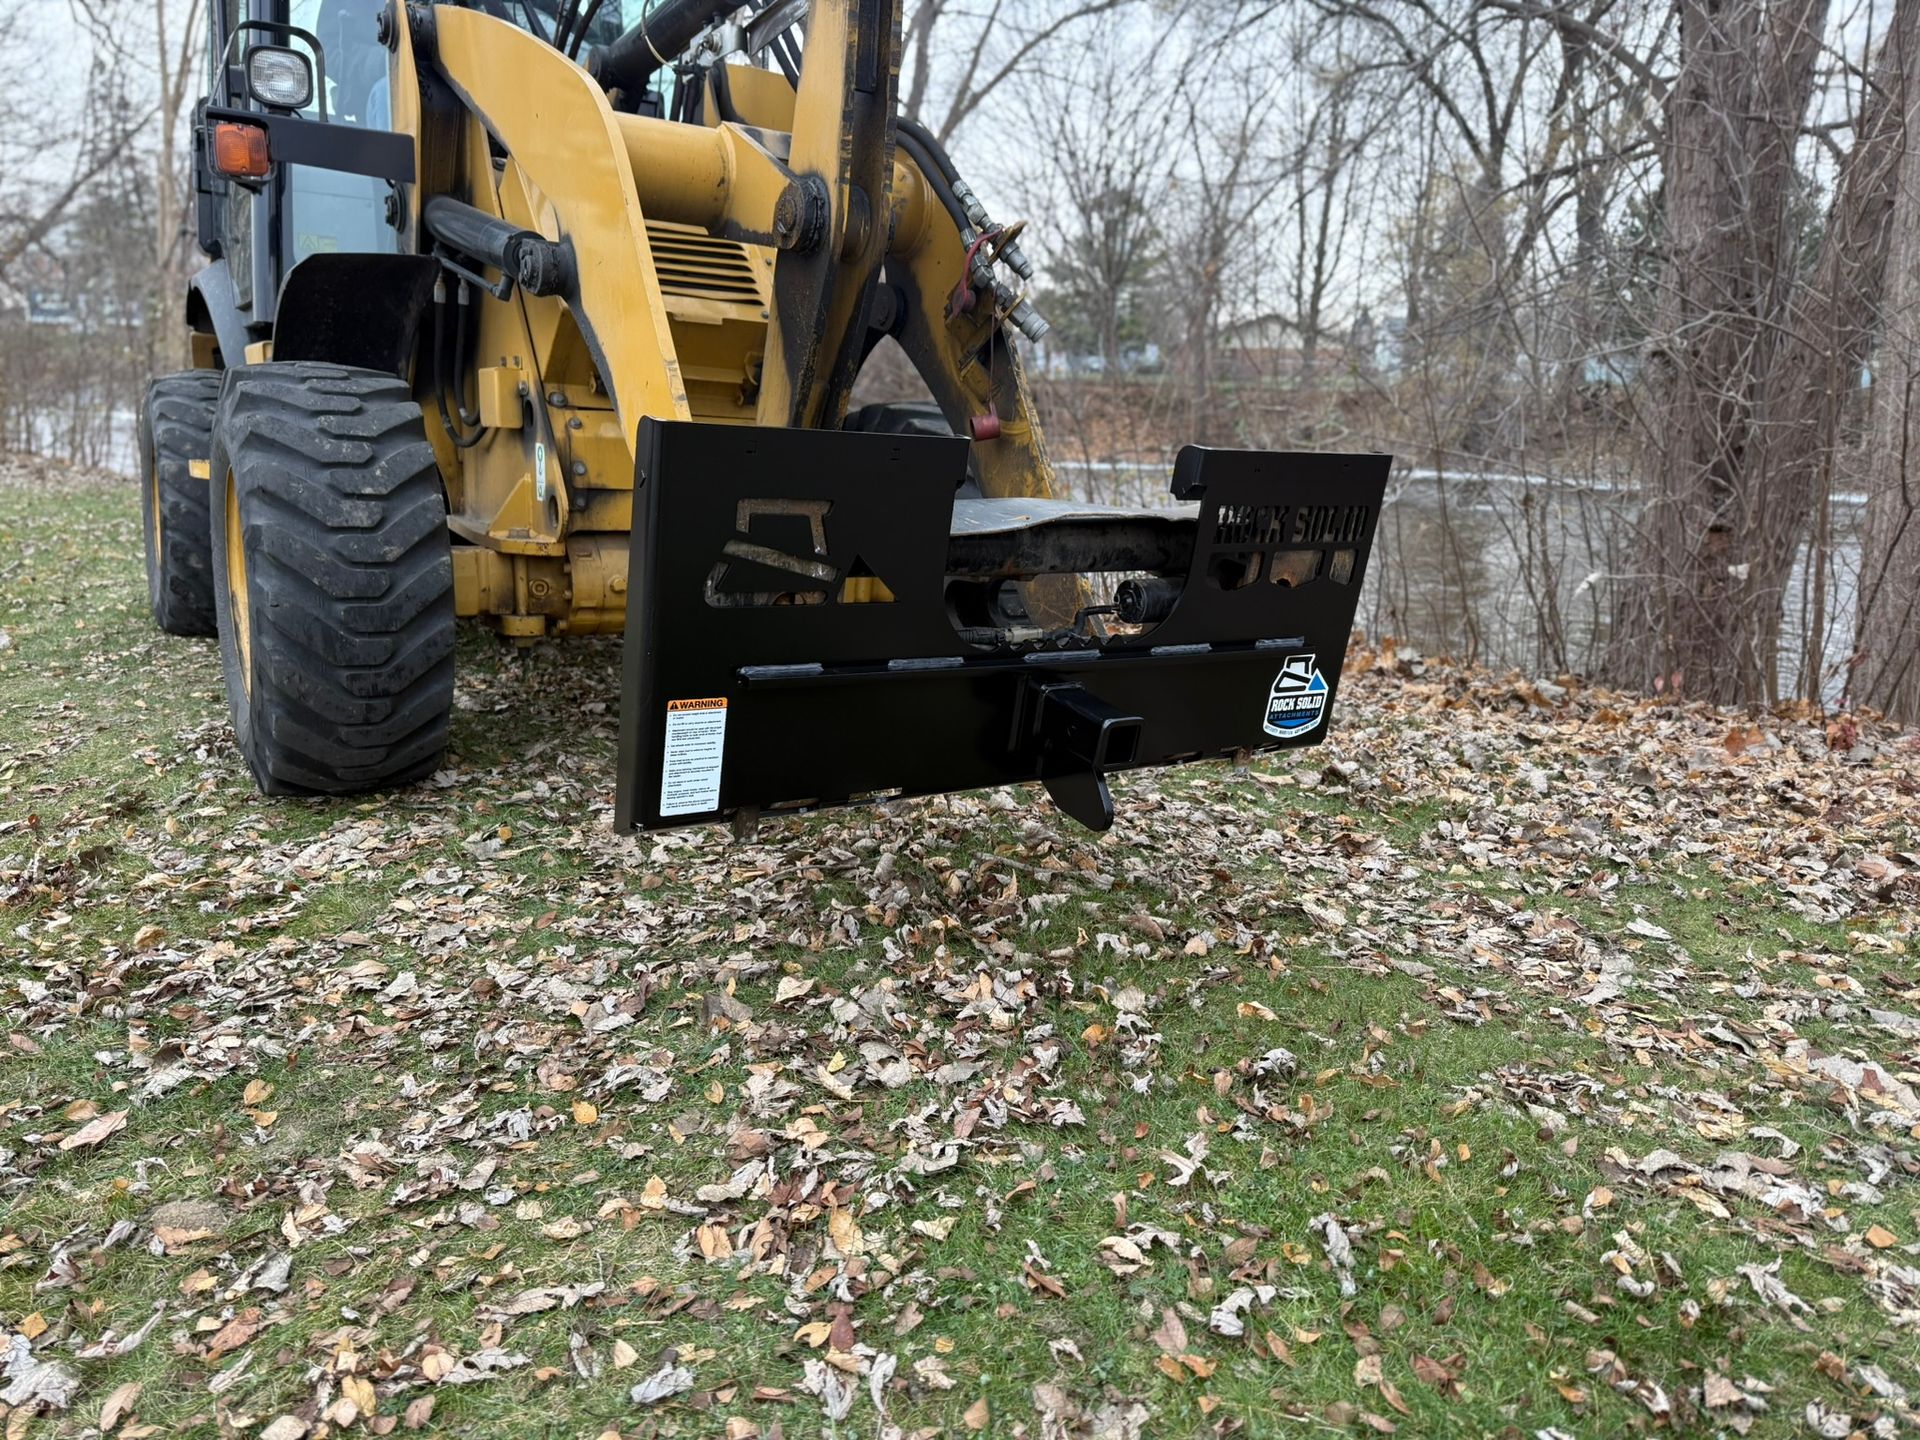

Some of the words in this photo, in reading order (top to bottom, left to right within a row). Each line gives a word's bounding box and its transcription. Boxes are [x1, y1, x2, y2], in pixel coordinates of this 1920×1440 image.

[1291, 505, 1369, 543] SOLID
[680, 699, 723, 709] WARNING
[1270, 697, 1296, 712] ROCK
[1296, 695, 1323, 709] SOLID
[1269, 709, 1319, 720] ATTACHMENTS
